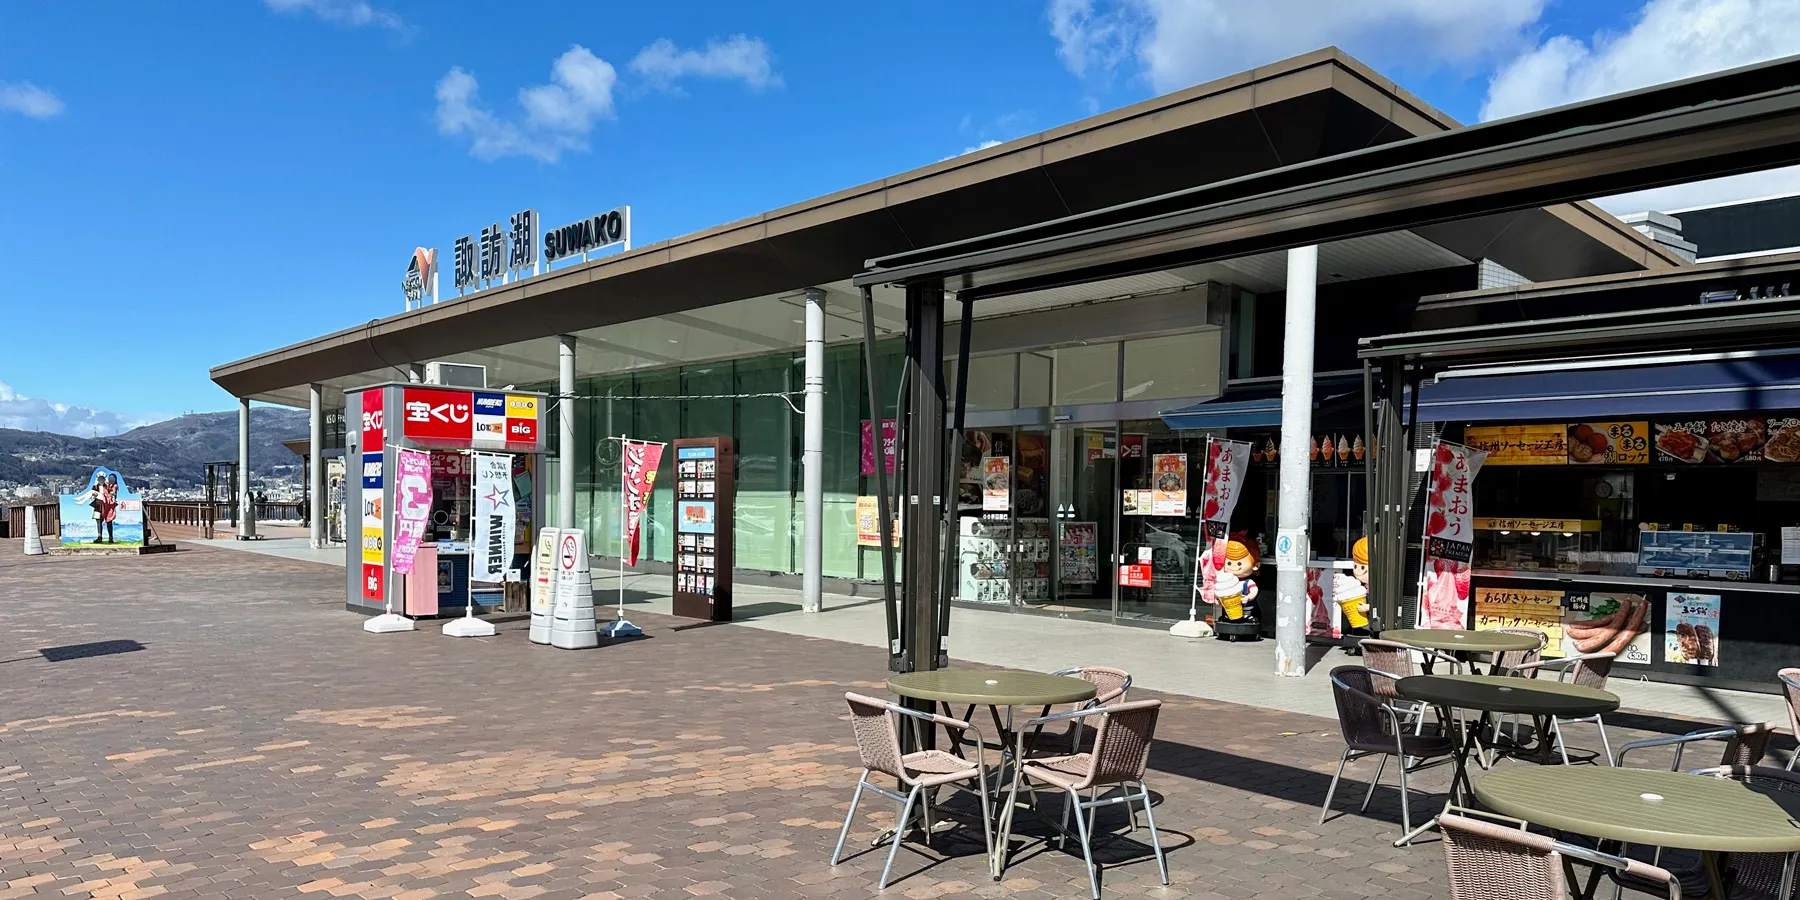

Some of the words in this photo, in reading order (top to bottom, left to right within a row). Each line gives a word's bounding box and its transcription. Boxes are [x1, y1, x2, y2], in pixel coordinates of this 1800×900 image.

[545, 210, 622, 262] SUWAKO
[455, 208, 532, 288] 諏訪湖
[406, 401, 469, 423] 宝くじ
[363, 410, 383, 431] 宝くじ
[1711, 419, 1747, 433] たこ焼き
[1609, 425, 1634, 437] まる
[1622, 437, 1647, 450] まる
[1604, 452, 1648, 464] 湖ロッケ
[1219, 447, 1233, 518] あまおう
[1448, 453, 1468, 536] あまおう
[1499, 519, 1565, 529] 信州ソーセージ工房
[1446, 541, 1471, 553] JAPAN
[1484, 592, 1554, 605] あらびきソーセージ
[1480, 615, 1555, 628] ガーリックソーセージ
[1627, 651, 1648, 661] 430円
